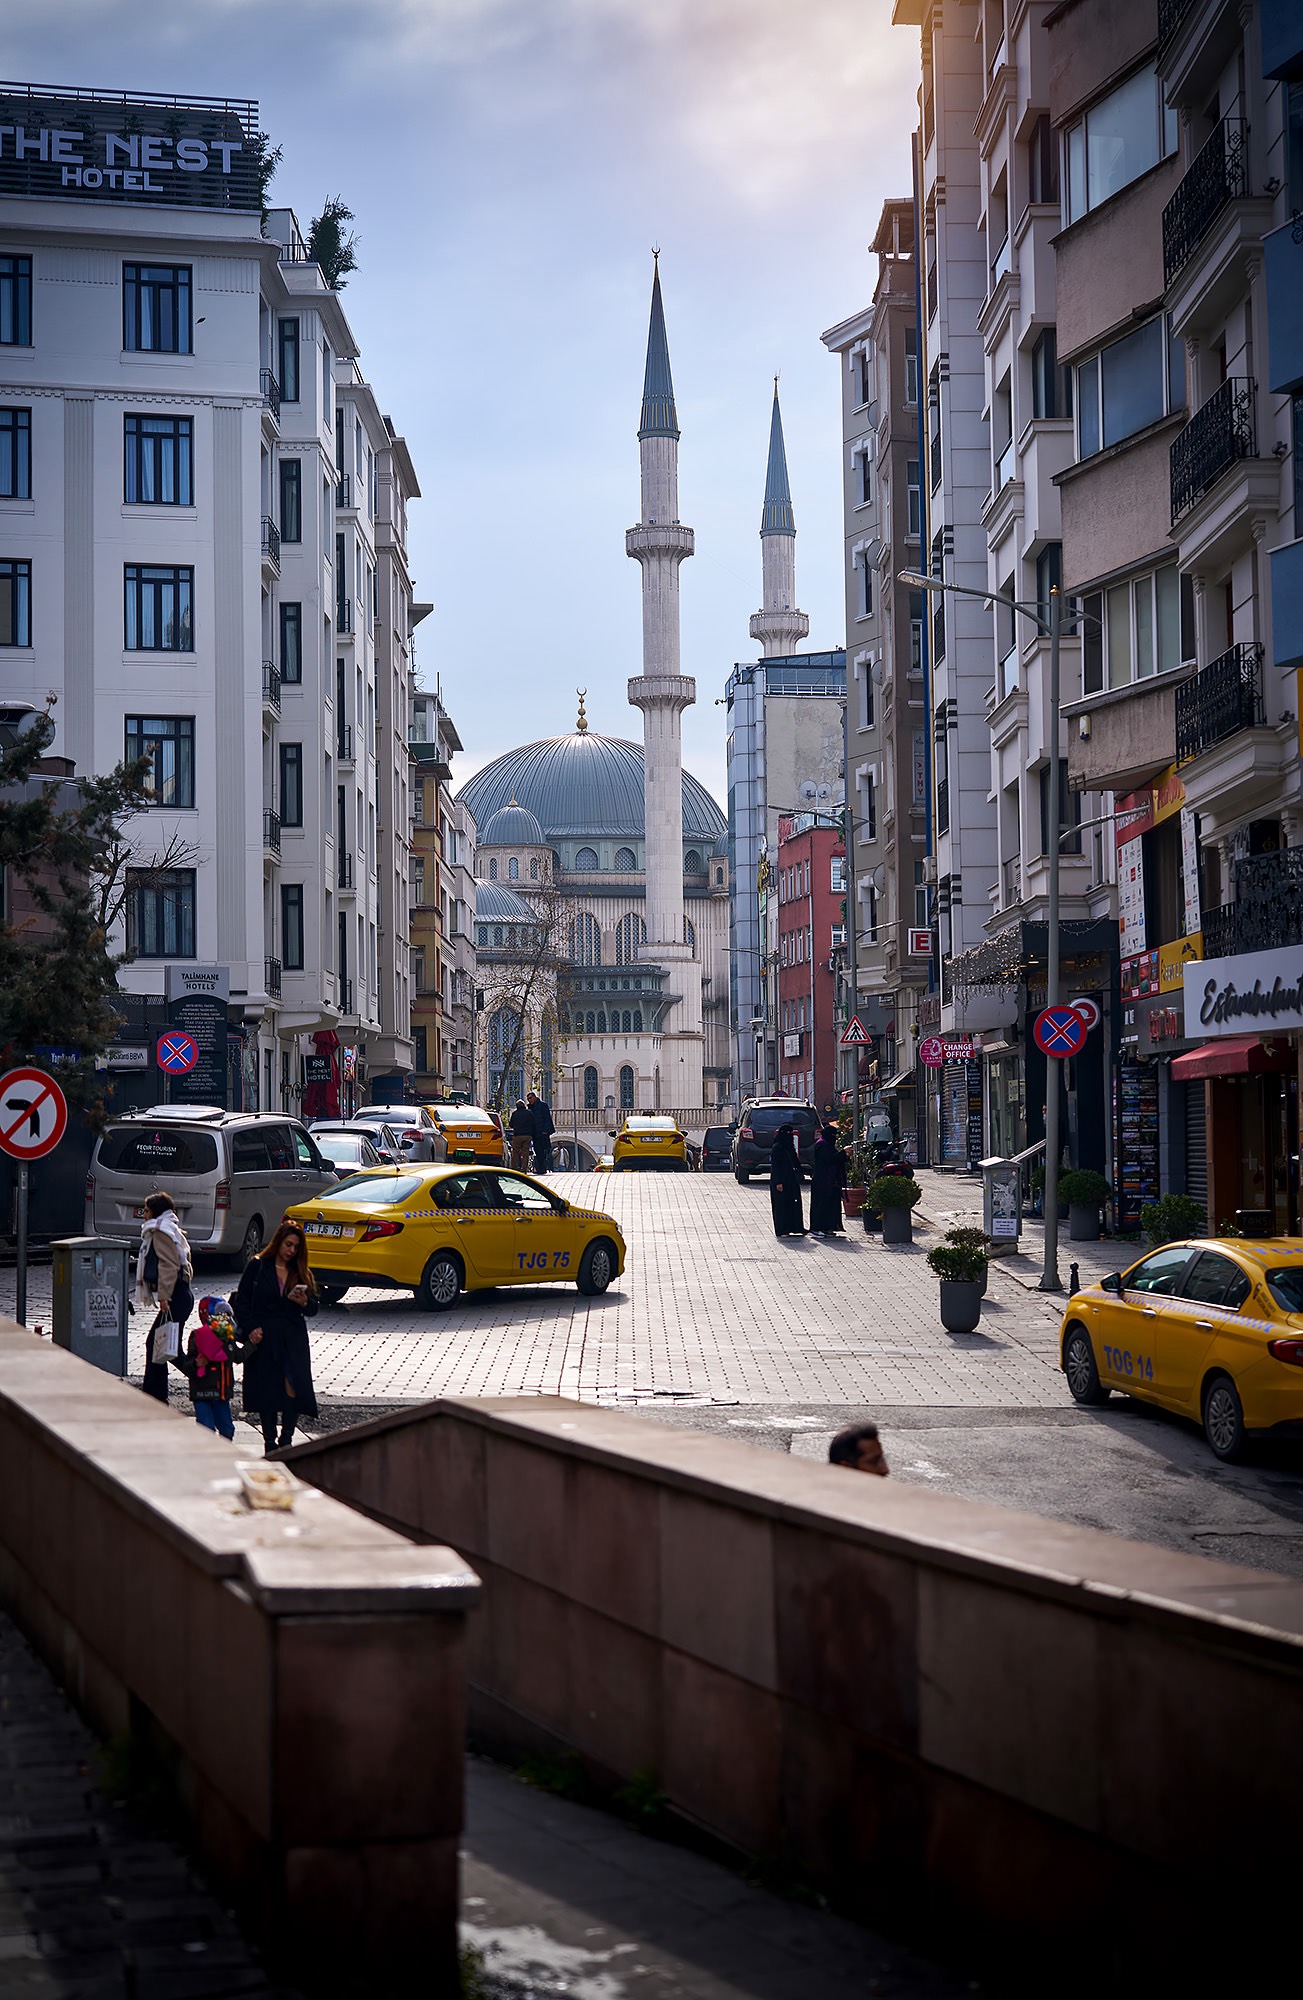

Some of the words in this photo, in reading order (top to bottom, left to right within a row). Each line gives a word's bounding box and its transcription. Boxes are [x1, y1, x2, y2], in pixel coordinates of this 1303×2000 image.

[0, 126, 84, 164] THE
[105, 132, 243, 174] NEST
[61, 166, 164, 192] HOTEL
[915, 933, 930, 951] E
[943, 1043, 973, 1051] CHANGE
[945, 1050, 971, 1058] OFFICE
[153, 1145, 177, 1153] TOURISM
[331, 1226, 340, 1235] 75
[517, 1251, 548, 1269] TJG
[553, 1251, 571, 1268] 75
[1103, 1345, 1133, 1375] TOG
[1137, 1353, 1155, 1382] 14
